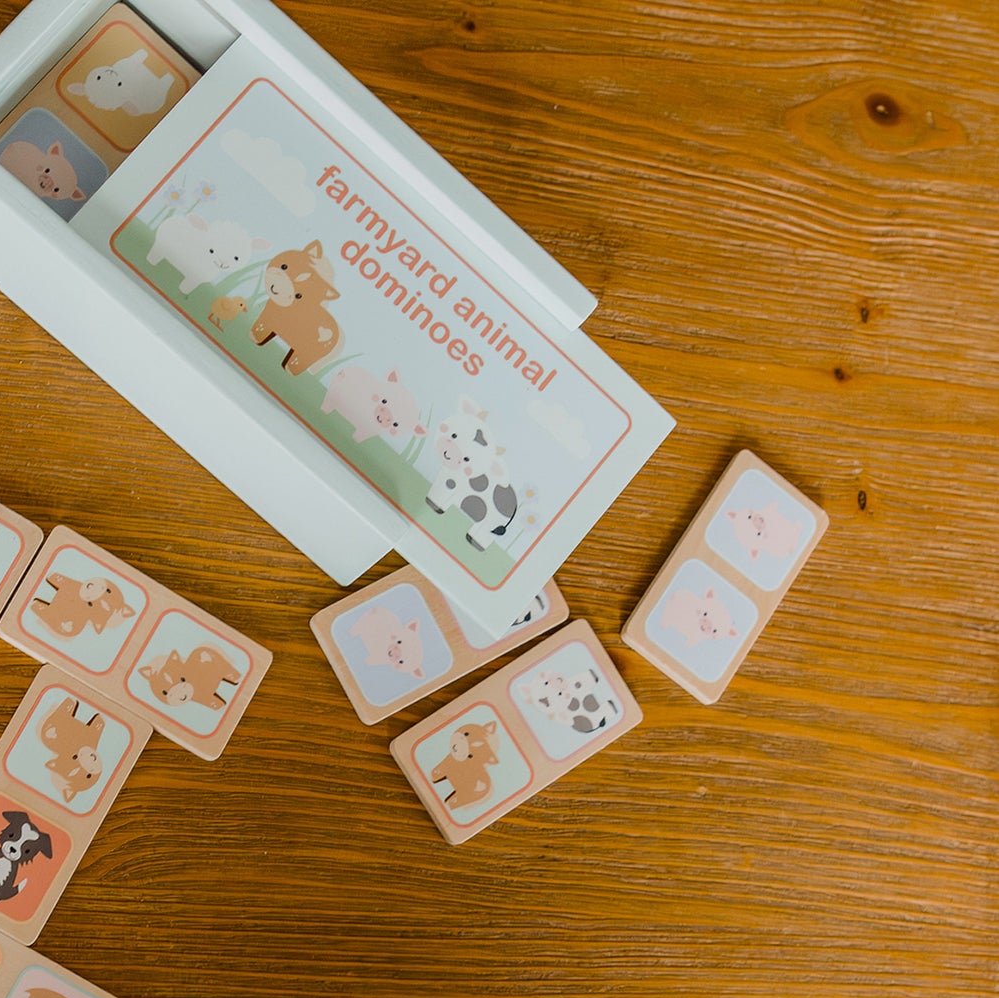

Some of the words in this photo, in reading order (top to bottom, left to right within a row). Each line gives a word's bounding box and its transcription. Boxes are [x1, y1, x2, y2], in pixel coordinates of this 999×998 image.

[315, 164, 458, 299] farmyard
[453, 296, 558, 392] animal
[340, 240, 485, 376] dominoes
